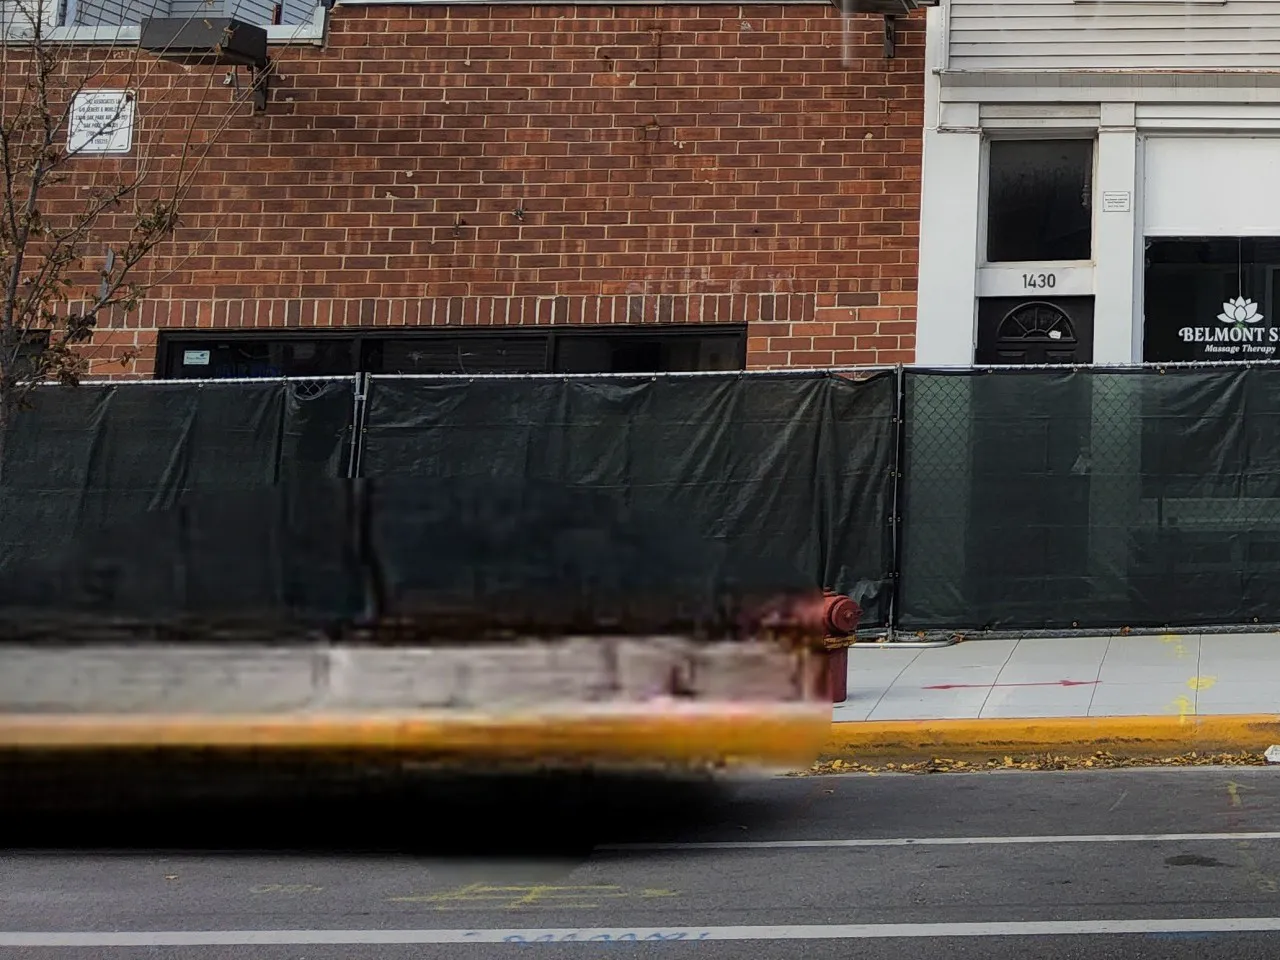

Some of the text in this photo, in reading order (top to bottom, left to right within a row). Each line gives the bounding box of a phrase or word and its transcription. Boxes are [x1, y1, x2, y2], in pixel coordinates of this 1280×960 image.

[1022, 273, 1056, 289] 1430
[1178, 326, 1266, 342] BELMONT
[1204, 344, 1276, 354] Massage Therapy
